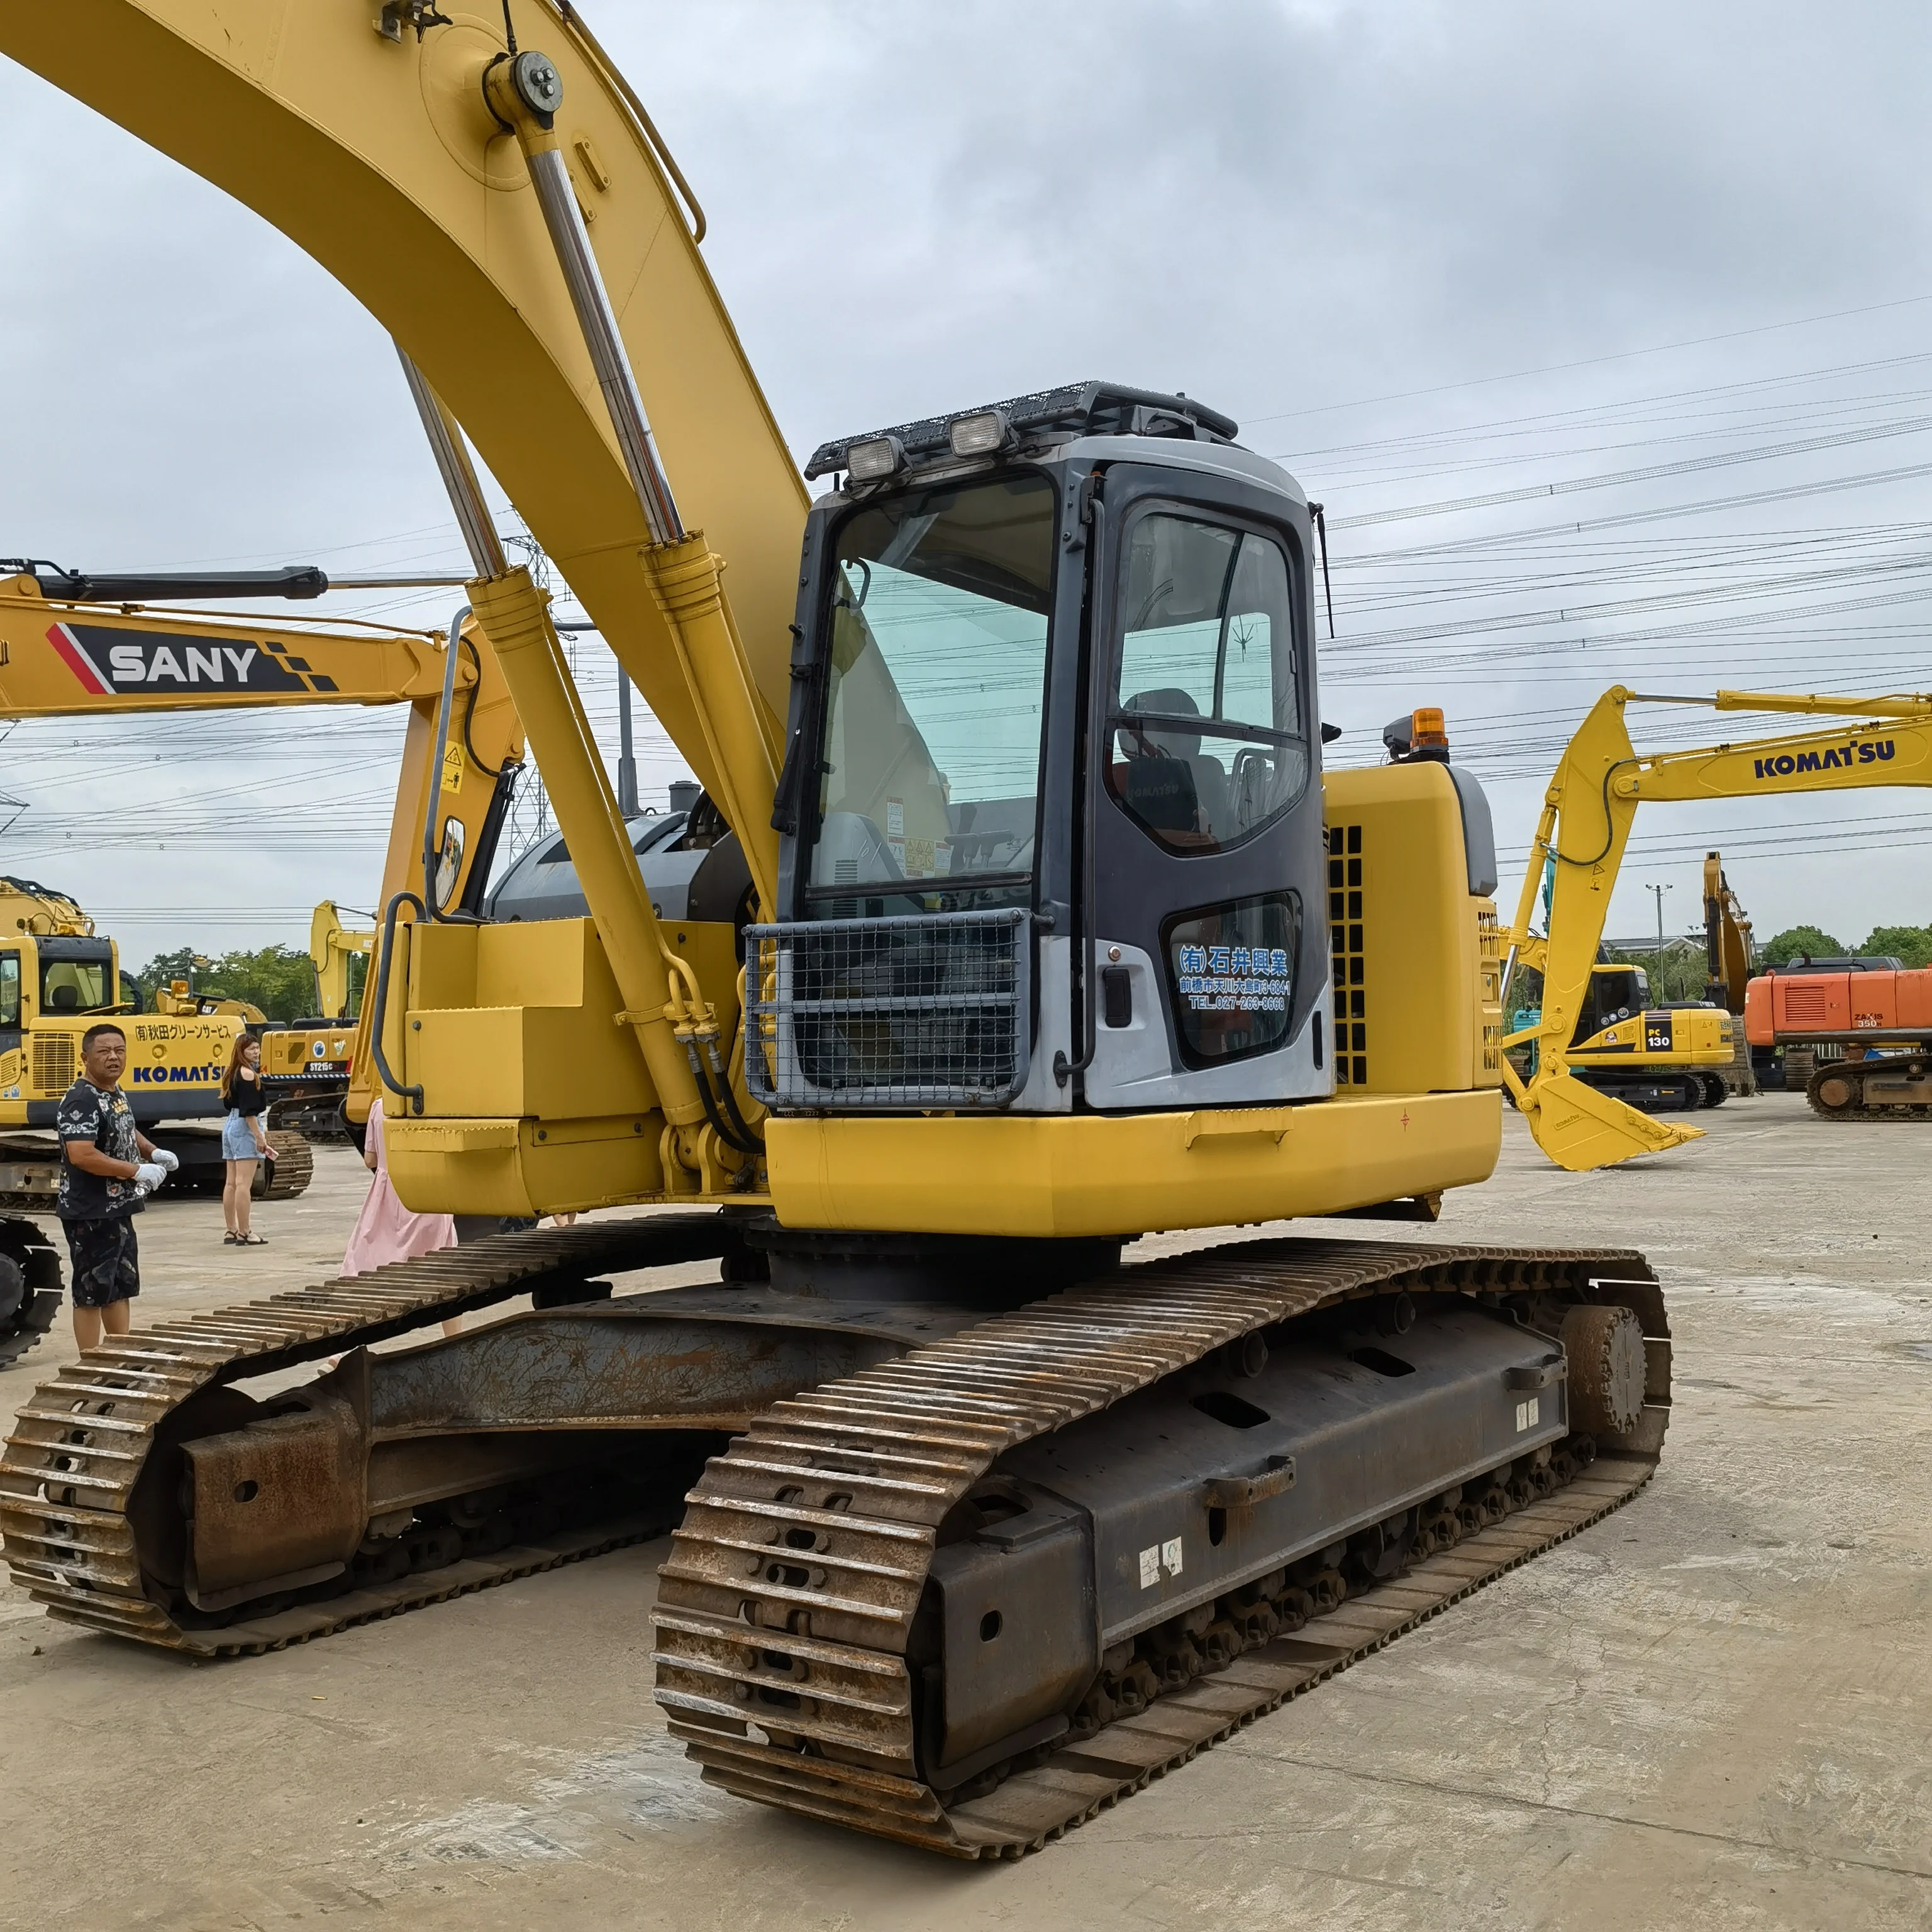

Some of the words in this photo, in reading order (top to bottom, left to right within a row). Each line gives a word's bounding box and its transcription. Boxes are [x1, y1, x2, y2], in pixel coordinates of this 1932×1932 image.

[109, 646, 257, 682] SANY
[1754, 740, 1895, 779] KOMATSU
[202, 1005, 212, 1014] CAT
[1648, 1037, 1670, 1046] 130
